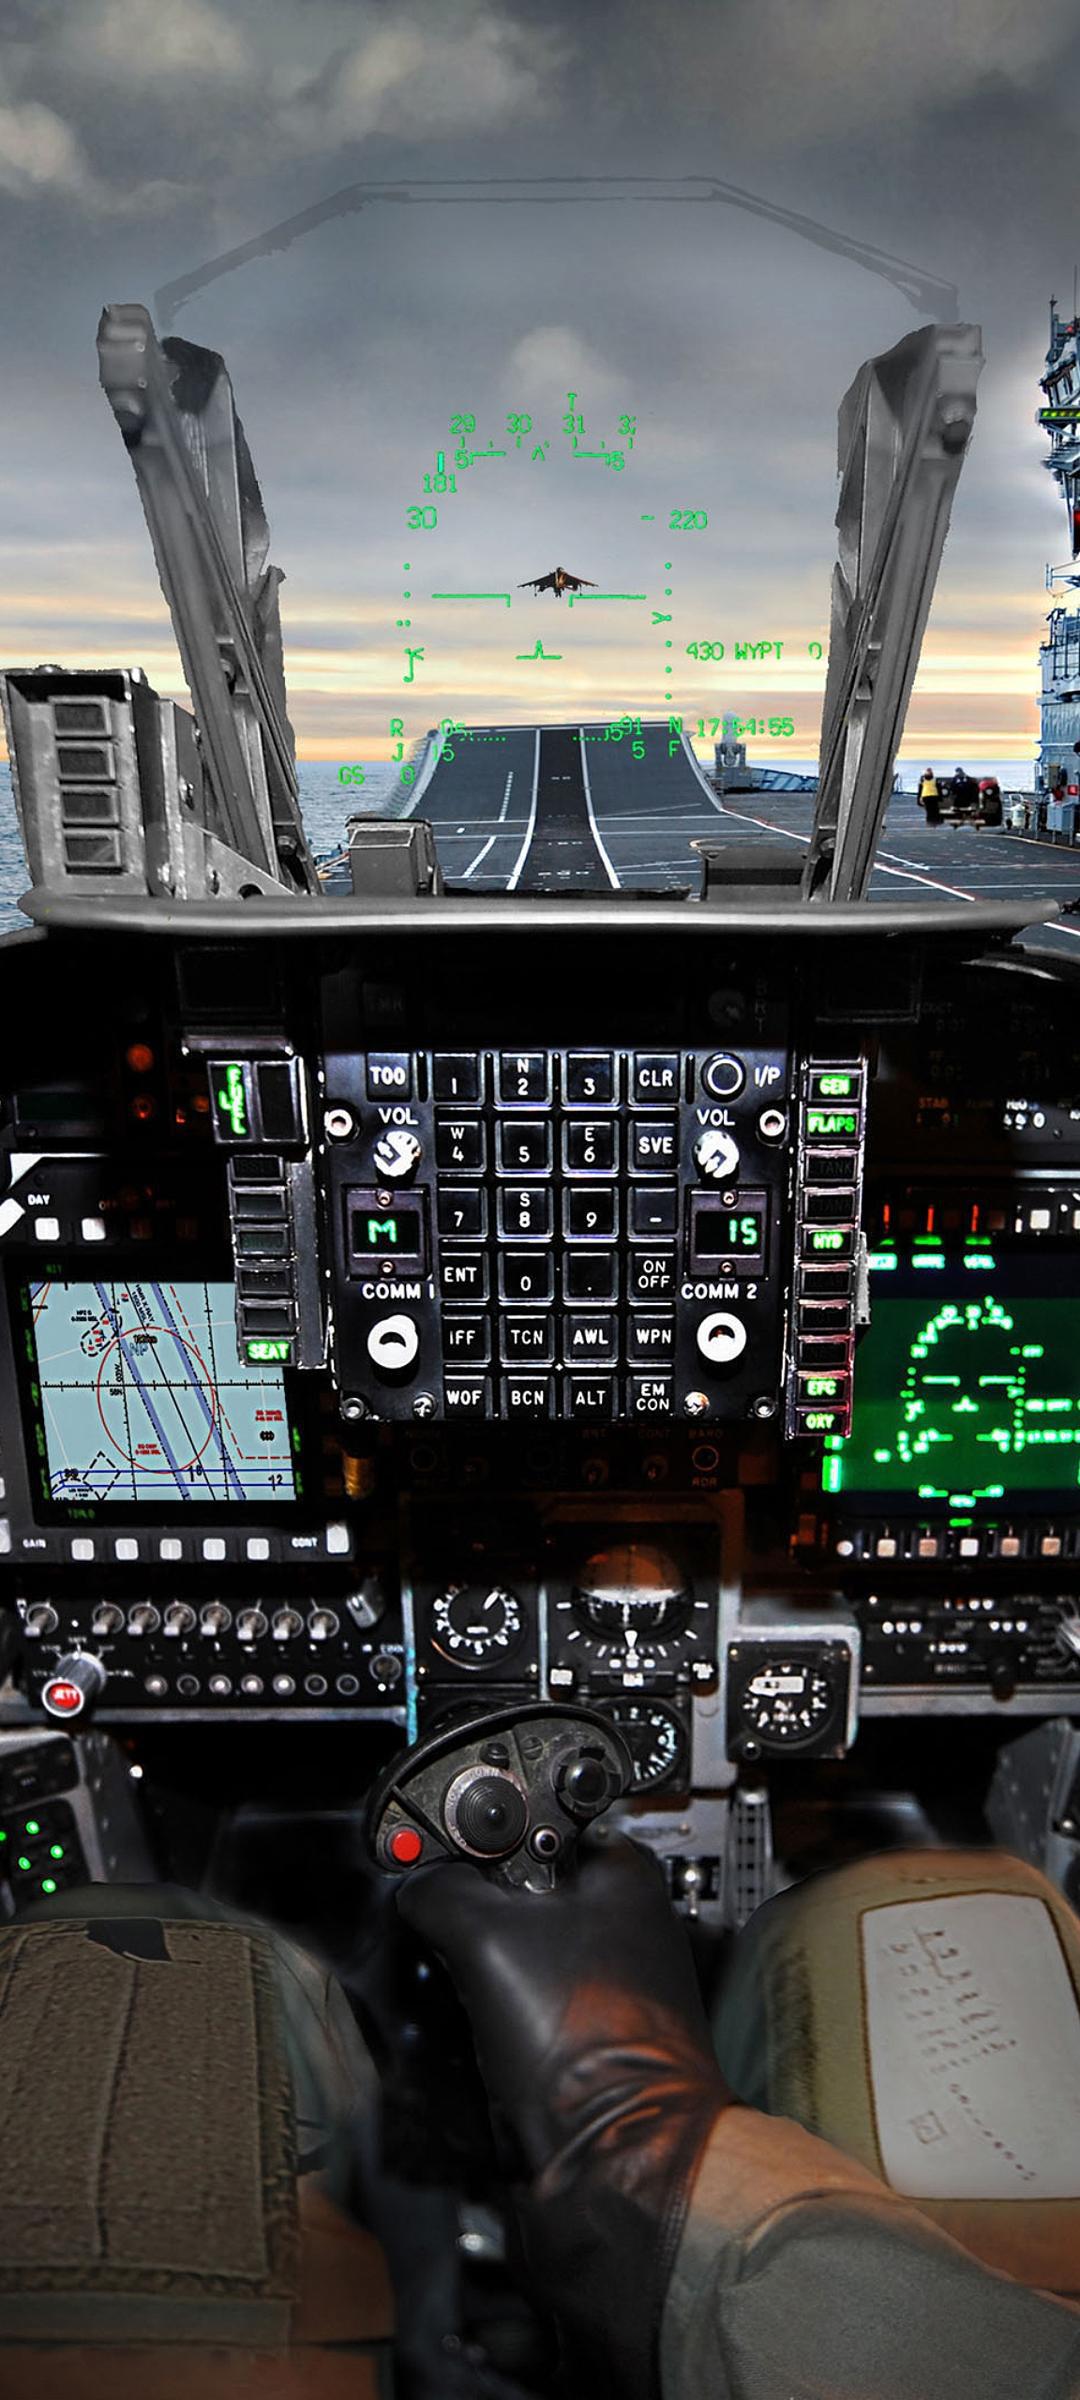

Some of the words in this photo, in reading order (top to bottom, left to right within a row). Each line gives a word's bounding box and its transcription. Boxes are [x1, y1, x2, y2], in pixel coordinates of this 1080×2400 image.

[449, 413, 476, 434] 29
[505, 412, 532, 434] 30
[562, 414, 585, 434] 31
[454, 450, 468, 469] 5
[423, 474, 457, 493] 181
[405, 505, 437, 529] 30
[669, 510, 708, 530] 220
[686, 641, 724, 660] 430
[735, 641, 783, 660] WYPT
[390, 718, 404, 737] R
[668, 716, 683, 736] N
[697, 717, 794, 737] 17:54:55
[391, 743, 404, 762] J
[631, 741, 646, 760] 5
[668, 741, 682, 759] F
[337, 765, 365, 785] GS
[518, 1059, 529, 1073] N
[639, 1069, 673, 1087] CLR
[754, 1066, 780, 1086] I/P
[451, 1078, 458, 1095] 1
[518, 1078, 529, 1095] 2
[584, 1078, 596, 1095] 3
[379, 1108, 419, 1125] VOL
[697, 1109, 735, 1126] VOL
[807, 1113, 856, 1133] FLAPS
[451, 1126, 464, 1140] W
[585, 1126, 595, 1141] E
[638, 1136, 673, 1154] SVE
[452, 1146, 464, 1162] 4
[519, 1146, 530, 1162] 5
[584, 1146, 596, 1162] 6
[28, 1194, 50, 1205] DAY
[519, 1192, 530, 1207] S
[454, 1211, 464, 1227] 7
[519, 1212, 530, 1228] 8
[586, 1212, 597, 1228] 9
[368, 1219, 397, 1244] M
[444, 1267, 477, 1283] ENT
[643, 1260, 666, 1274] ON
[520, 1276, 531, 1291] 0
[638, 1276, 670, 1289] OFF
[362, 1283, 421, 1300] COMM
[681, 1283, 739, 1300] COMM
[747, 1284, 757, 1300] 2
[449, 1329, 476, 1345] IFF
[510, 1329, 543, 1345] TCN
[573, 1329, 608, 1345] AWL
[636, 1328, 672, 1344] WPN
[247, 1342, 290, 1360] SEAT
[446, 1390, 482, 1406] WOF
[511, 1390, 544, 1406] BCN
[576, 1390, 606, 1406] ALT
[640, 1383, 665, 1397] EM
[636, 1398, 670, 1411] CON
[806, 1413, 835, 1429] OXY
[291, 1537, 318, 1548] CONT
